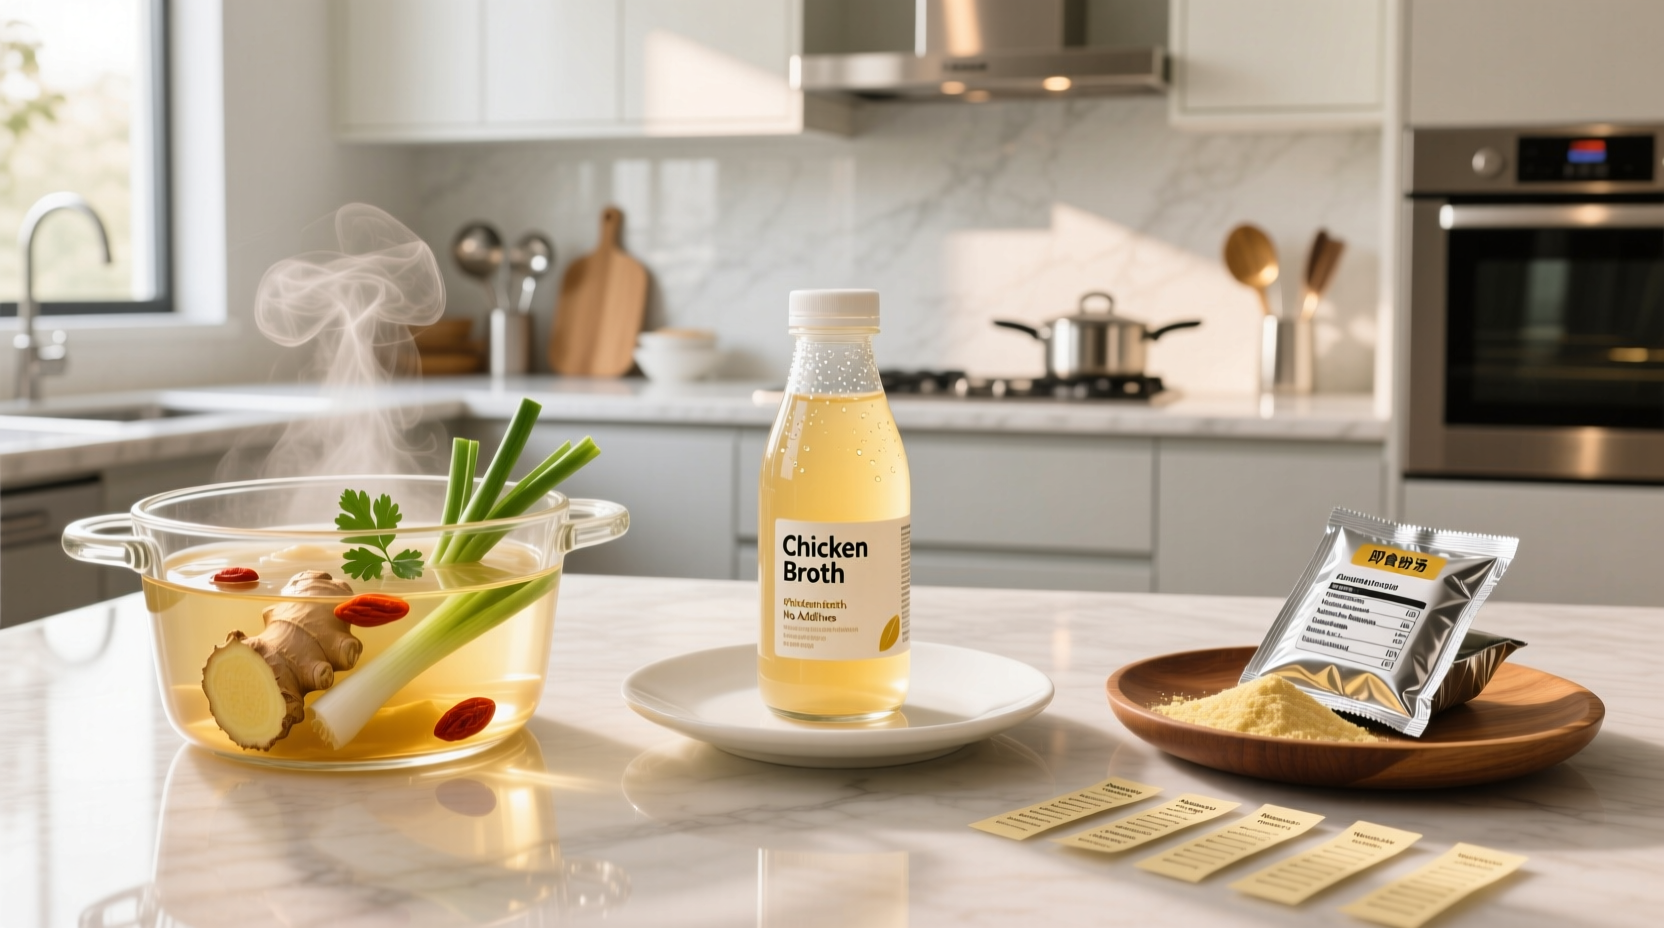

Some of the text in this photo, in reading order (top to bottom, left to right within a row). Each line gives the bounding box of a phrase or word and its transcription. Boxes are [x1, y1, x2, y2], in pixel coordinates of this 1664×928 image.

[783, 534, 868, 558] Chicken
[783, 560, 845, 584] Broth
[783, 609, 795, 621] No
